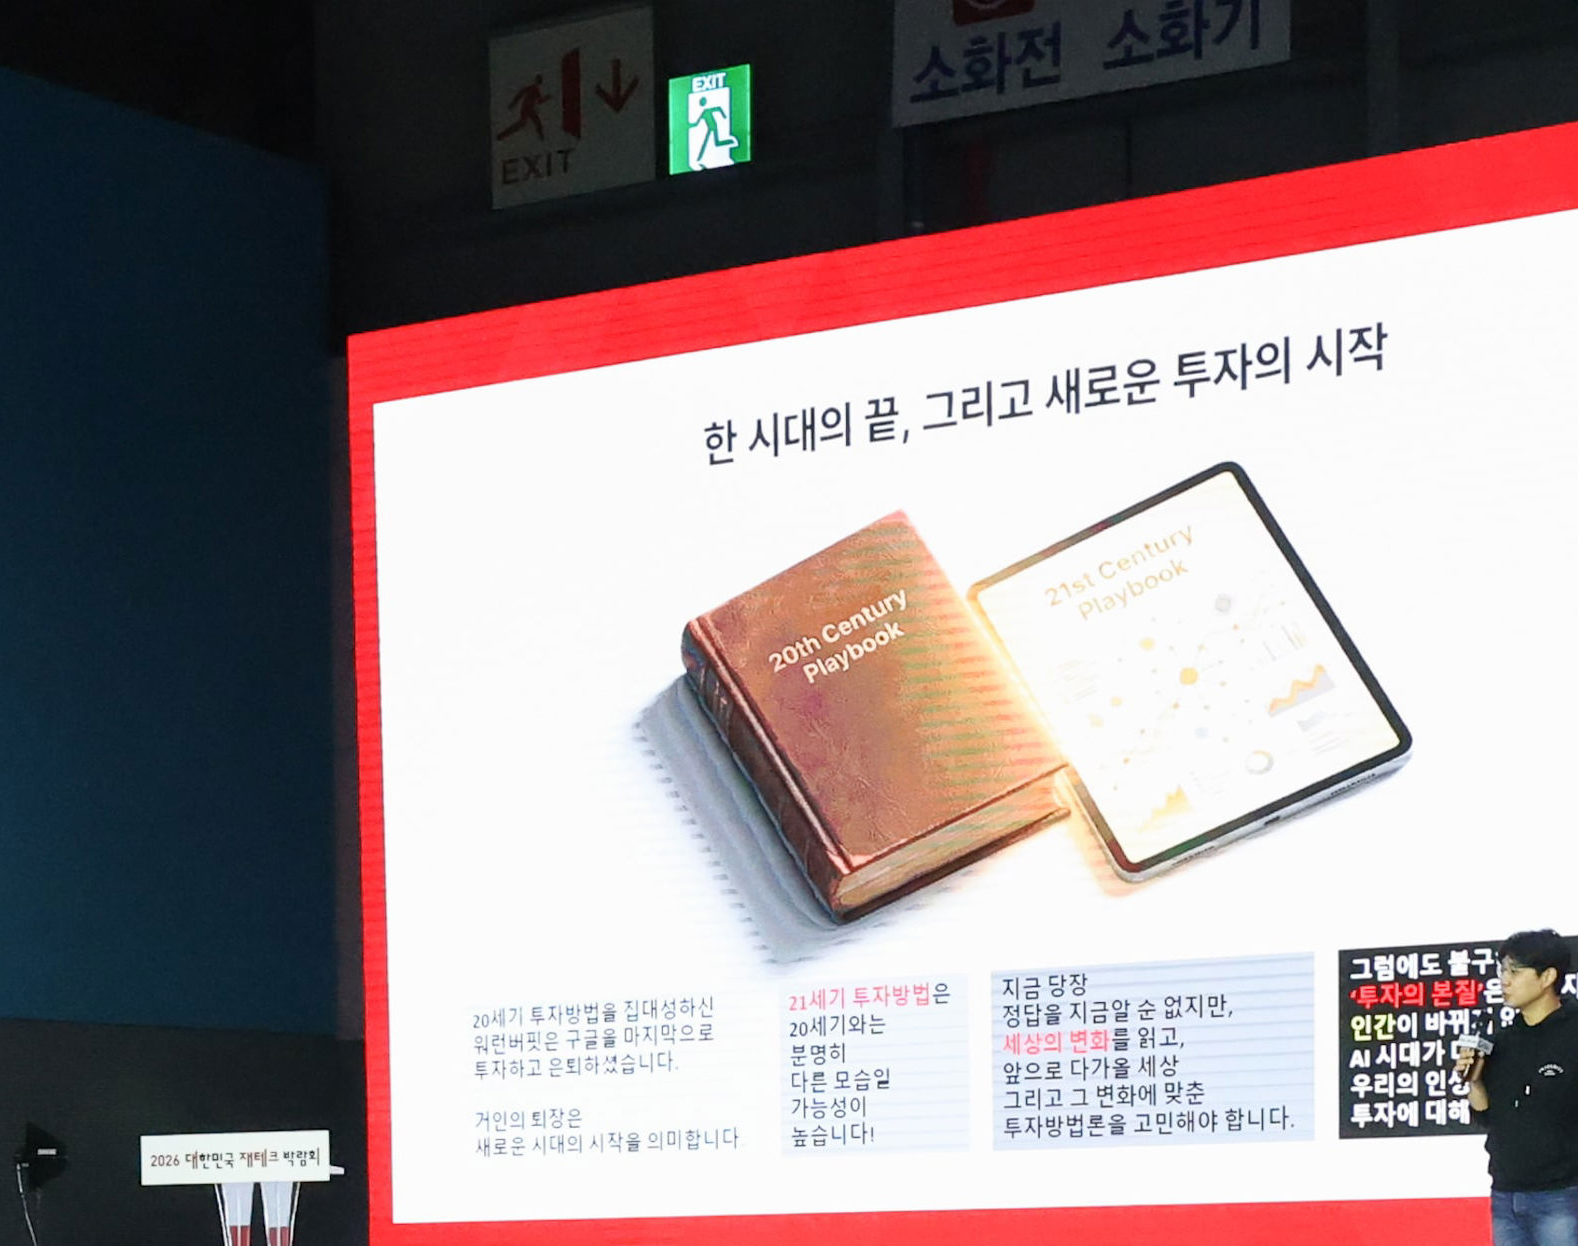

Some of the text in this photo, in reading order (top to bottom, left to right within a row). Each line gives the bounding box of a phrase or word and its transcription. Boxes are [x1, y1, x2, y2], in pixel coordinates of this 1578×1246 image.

[910, 0, 1260, 103] 소화전 소화기
[692, 73, 726, 92] EXIT
[502, 150, 572, 185] EXIT
[704, 321, 1389, 466] 한 시대의 끝, 그리고 새로운 투자의 시작
[1045, 524, 1195, 607] 21st Century
[1077, 557, 1190, 622] Playbook
[768, 589, 909, 674] 20th Century
[803, 620, 906, 684] Playbook
[1350, 953, 1443, 982] 그럼에도
[789, 982, 950, 1011] 21세기 투자방법은
[1002, 973, 1088, 1001] 지금 당장
[473, 996, 714, 1029] 20세기 투자방법을 집대성하신
[789, 1014, 886, 1037] 20세기와는
[1002, 994, 1233, 1029] 정답을 지금알 순 없지만,
[474, 1023, 714, 1055] 워런버핏은 구글을 마지막으로
[1003, 1026, 1185, 1055] 세상의 변화를 읽고,
[1350, 1012, 1418, 1041] 인간이
[474, 1050, 679, 1080] 투자하고 은퇴하셨습니다.
[790, 1043, 846, 1067] 분명히
[1349, 1049, 1371, 1068] AI
[1375, 1040, 1445, 1069] 시대가
[791, 1068, 891, 1094] 다른 모습일
[1003, 1054, 1180, 1085] 앞으로 다가올 세상
[1003, 1081, 1206, 1111] 그리고 그 변화에 맞춘
[1350, 1071, 1419, 1098] 우리의
[475, 1108, 582, 1132] 거인의 퇴장은
[791, 1095, 866, 1120] 가능성이
[1003, 1105, 1295, 1139] 투자방법론을 고민해야 합니다.
[1350, 1100, 1419, 1128] 투자에
[1425, 1099, 1471, 1125] 대해
[476, 1136, 526, 1157] 새로운
[532, 1133, 582, 1155] 시대의
[590, 1131, 641, 1153] 시작을
[791, 1121, 875, 1148] 높습니다!
[150, 1147, 320, 1169] 2026 대한민국 재테크 박람회
